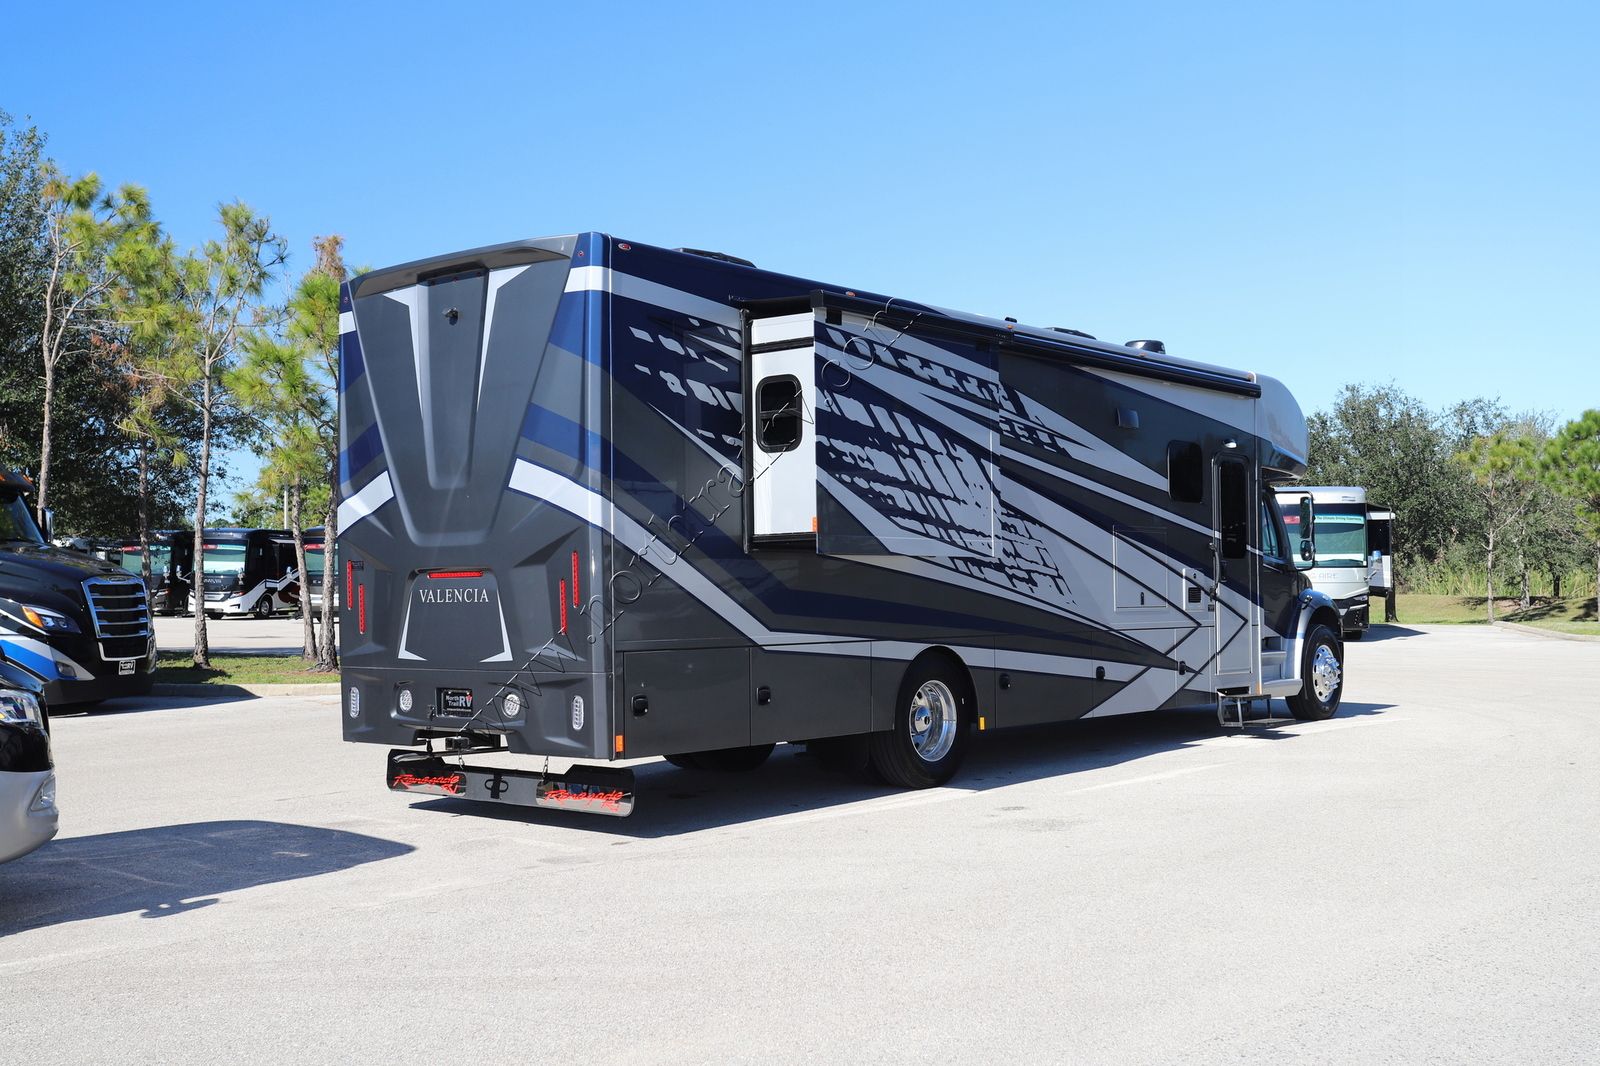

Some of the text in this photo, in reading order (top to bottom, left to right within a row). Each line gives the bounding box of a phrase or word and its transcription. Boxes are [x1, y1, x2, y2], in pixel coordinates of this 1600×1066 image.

[419, 588, 489, 603] VALENCIA
[459, 694, 473, 708] RV
[544, 789, 624, 807] Renegade
